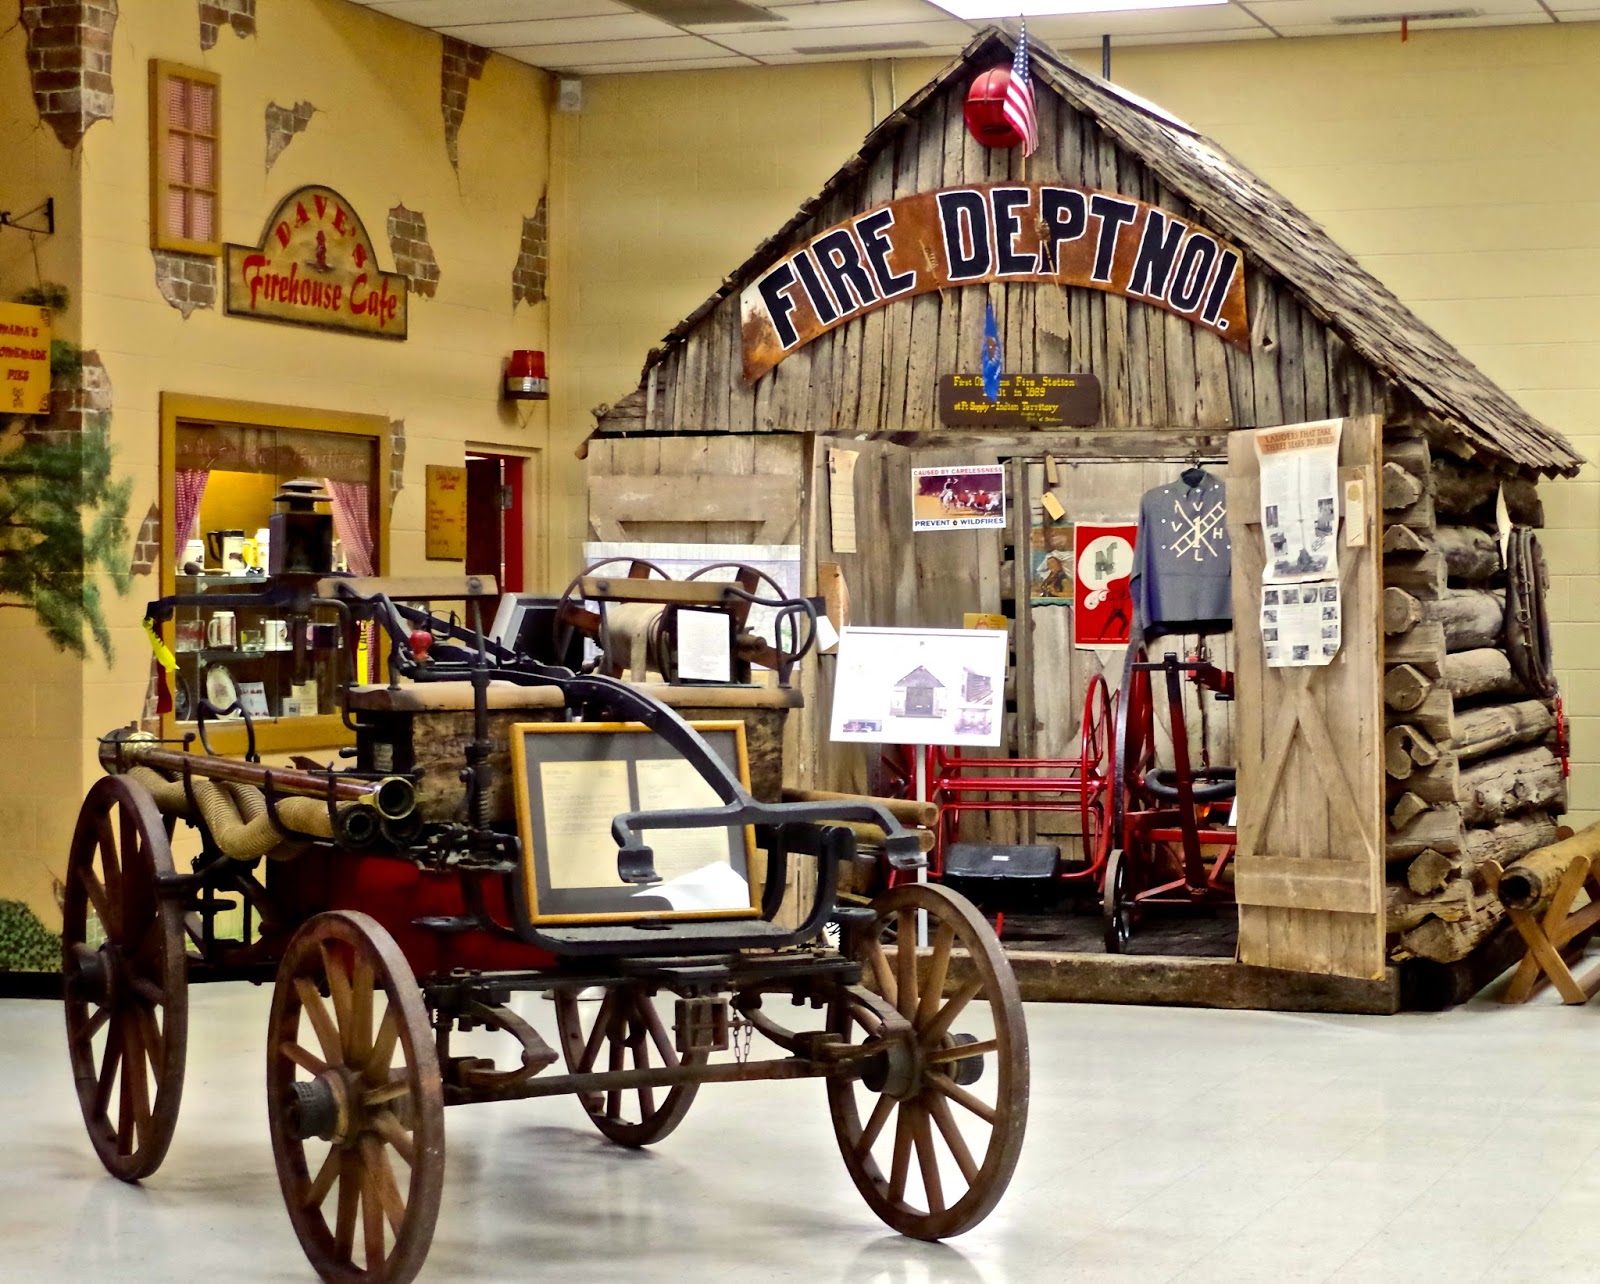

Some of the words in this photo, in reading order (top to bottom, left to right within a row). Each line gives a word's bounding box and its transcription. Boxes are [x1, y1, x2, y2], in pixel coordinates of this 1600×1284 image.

[275, 194, 369, 269] DAVE'S
[757, 206, 917, 351] FIRE
[935, 186, 1139, 284] DEPT
[242, 253, 343, 312] Firehouse
[350, 272, 398, 329] Cafe
[0, 346, 47, 361] OMEMADE
[953, 376, 973, 387] First
[1015, 376, 1036, 387] Fire
[1042, 376, 1076, 387] Station
[969, 401, 990, 413] Supply
[996, 401, 1020, 411] Indian
[1021, 401, 1059, 414] Territory
[951, 466, 1003, 475] CARELESSNESS
[914, 519, 951, 527] PREVENT
[960, 517, 1004, 526] WILDFIRES
